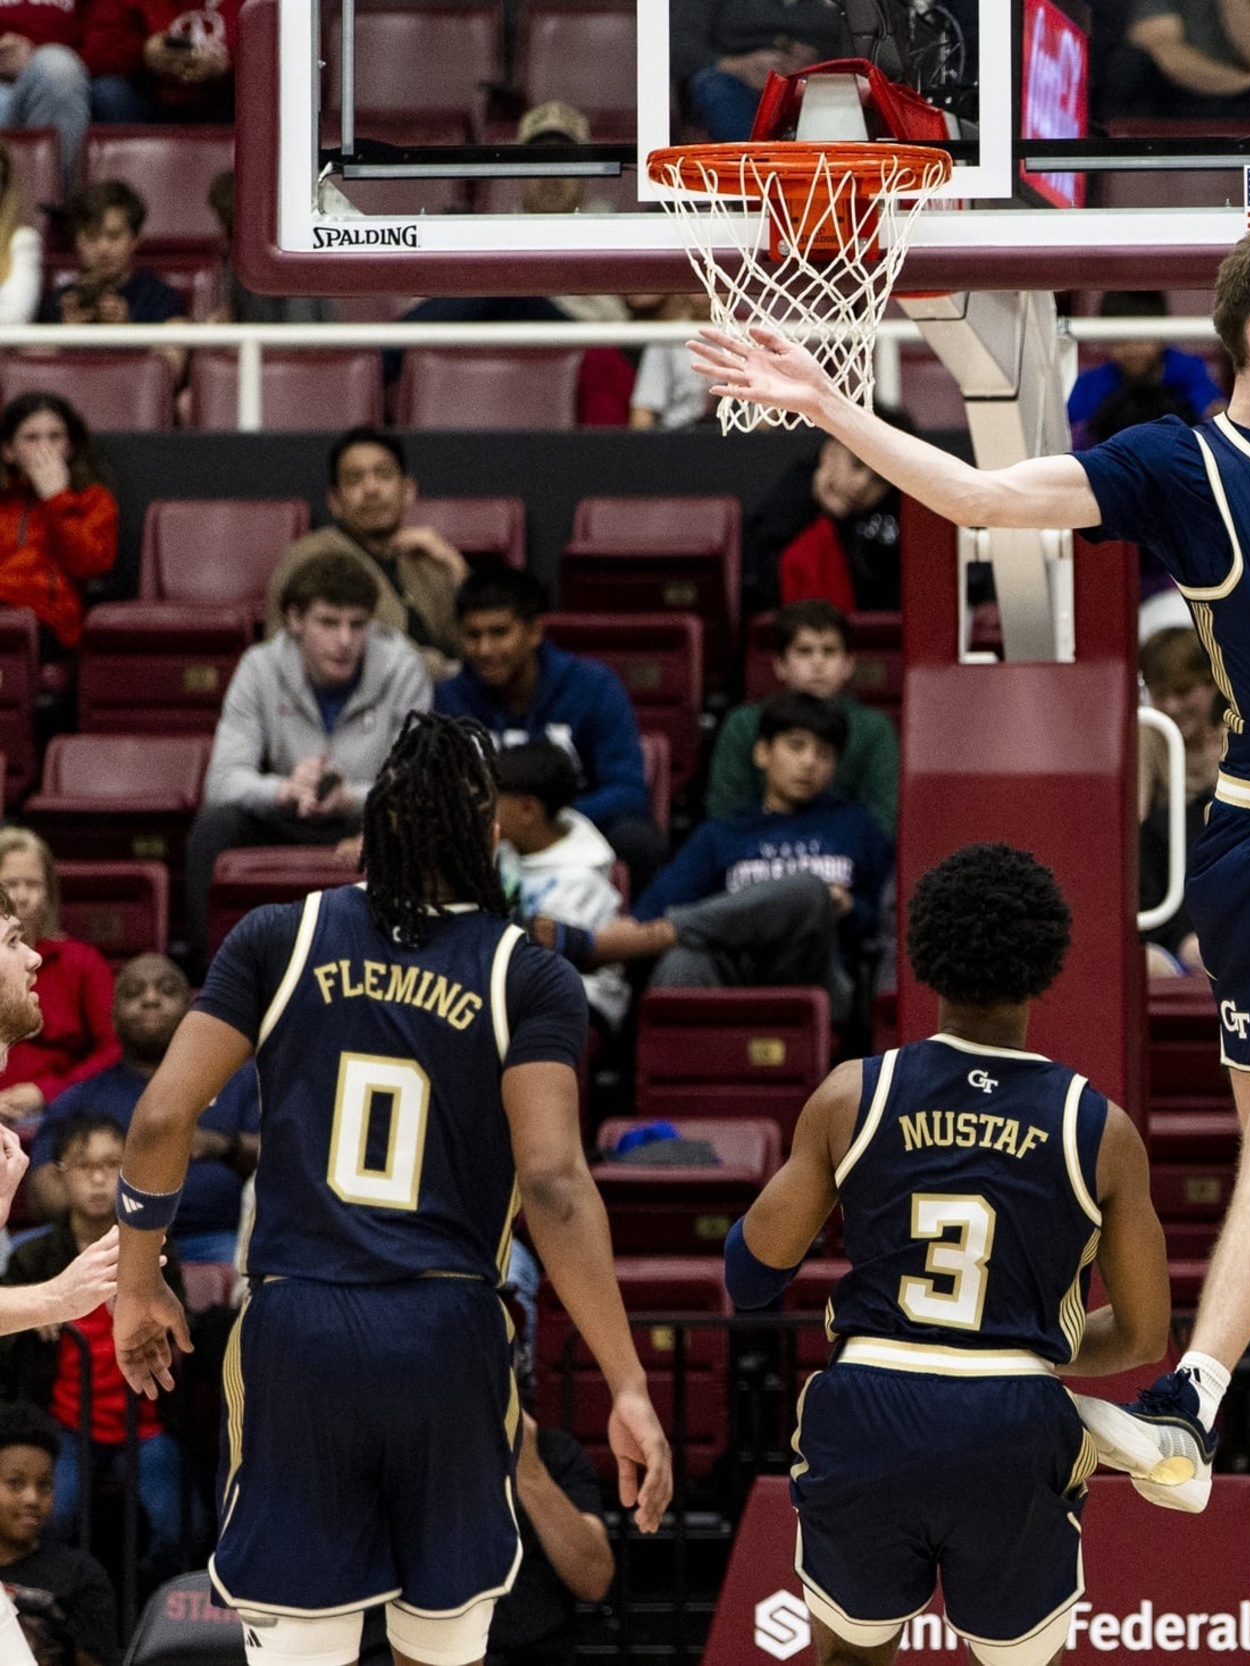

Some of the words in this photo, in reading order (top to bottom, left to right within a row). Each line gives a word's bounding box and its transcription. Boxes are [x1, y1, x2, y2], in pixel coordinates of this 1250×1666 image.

[313, 225, 417, 249] SPALDING
[313, 958, 483, 1030] FLEMING
[1220, 999, 1250, 1040] GT
[967, 1069, 999, 1094] GT
[326, 1051, 431, 1211] 0
[898, 1110, 1050, 1160] MUSTAF
[897, 1193, 997, 1331] 3
